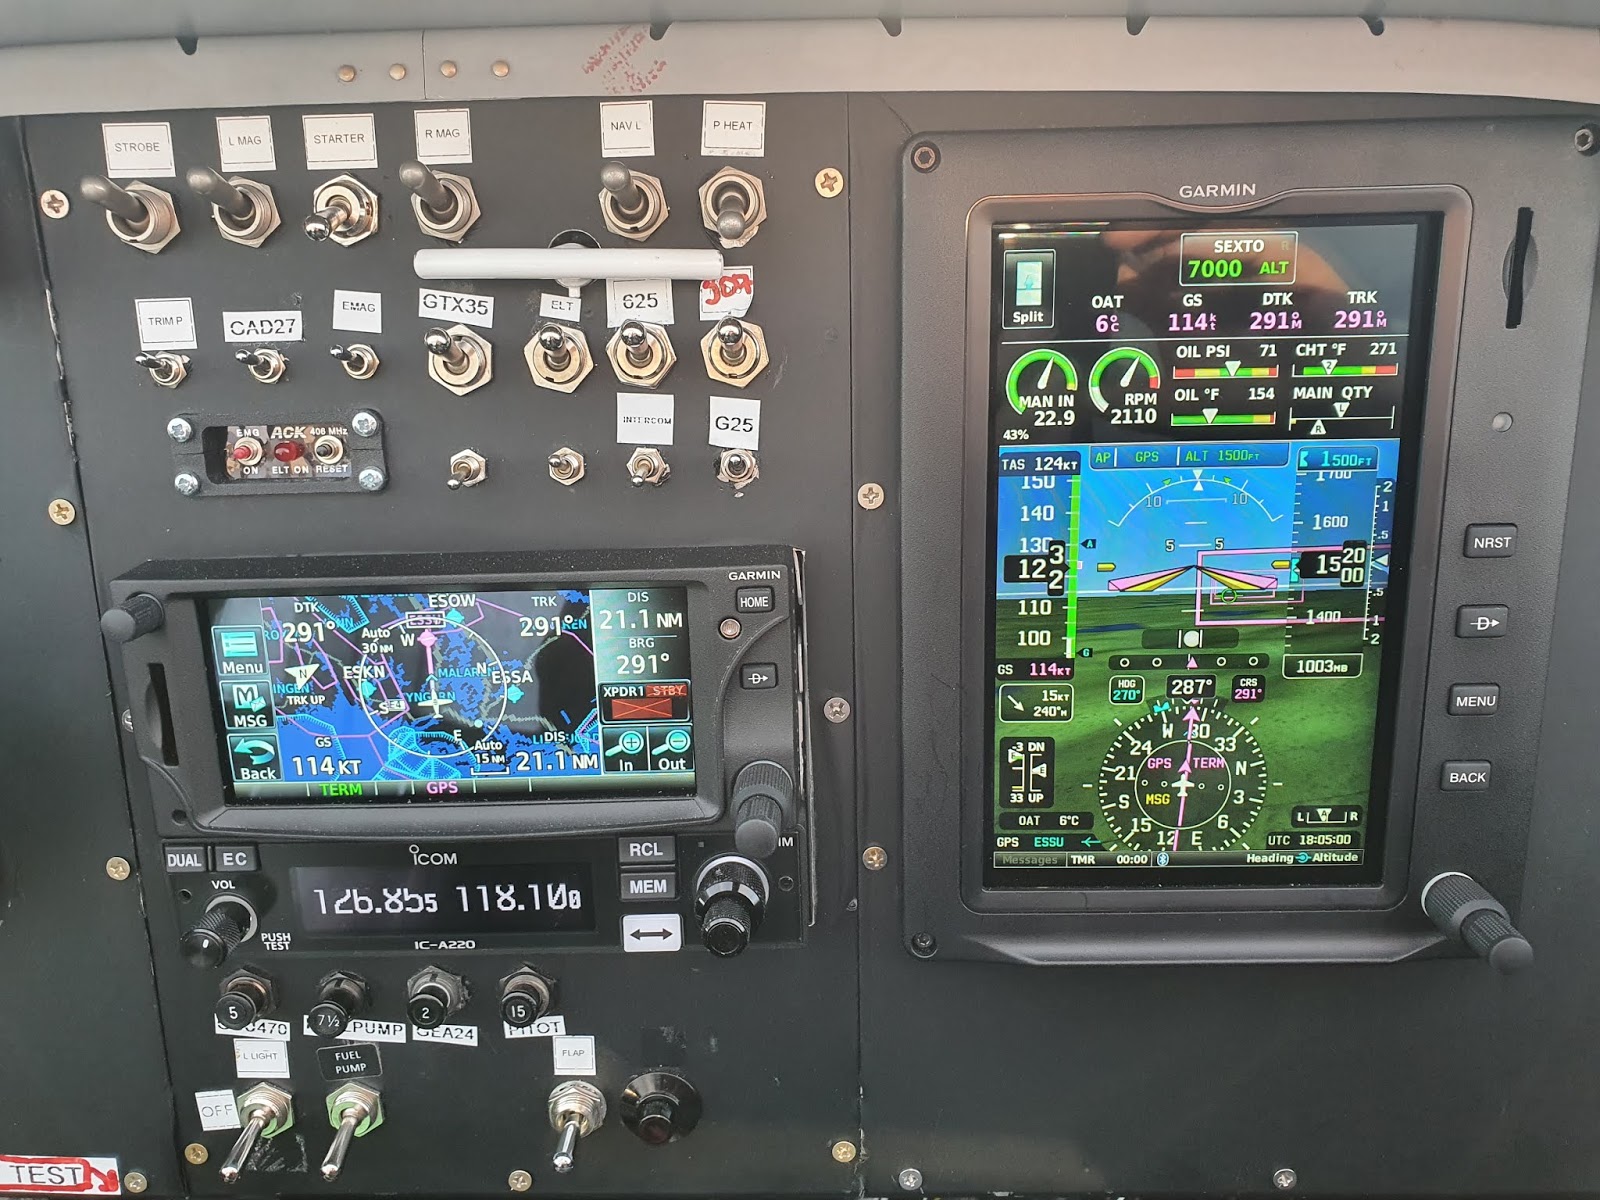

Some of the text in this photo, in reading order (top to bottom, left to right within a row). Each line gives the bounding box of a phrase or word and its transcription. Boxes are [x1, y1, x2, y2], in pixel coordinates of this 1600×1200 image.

[611, 120, 641, 131] NAV L
[713, 120, 753, 131] P HEAT
[313, 133, 365, 145] STARTER
[425, 127, 460, 139] R MAG
[228, 134, 262, 146] L MAG
[114, 141, 161, 153] STROBE
[1179, 183, 1257, 198] GARMIN
[1214, 240, 1265, 253] SEXTO
[1188, 259, 1290, 278] 7000 ALT
[622, 293, 658, 309] 625
[1091, 295, 1124, 309] OAT
[1182, 294, 1203, 307] GS
[1262, 292, 1294, 306] DTK
[1347, 290, 1378, 304] TRK
[342, 301, 376, 313] EMAG
[423, 293, 489, 316] GTX35
[551, 300, 574, 312] ELT
[148, 316, 183, 328] TRIM P
[1012, 311, 1044, 325] Split
[230, 318, 296, 336] CAD27
[1175, 344, 1278, 359] OIL PSI 71
[1295, 342, 1397, 357] CHT 271
[1174, 387, 1276, 401] OIL 154
[1293, 385, 1373, 399] MAIN QTY
[1019, 394, 1075, 408] MAN IN
[1124, 392, 1158, 406] RPM
[623, 416, 672, 425] INTERCOM
[1033, 410, 1076, 427] 22.9
[1110, 408, 1158, 425] 2110
[328, 427, 348, 435] MHz
[715, 416, 754, 433] G25
[236, 429, 260, 437] EMG
[270, 426, 307, 439] ACK
[1002, 429, 1030, 440] 43%
[1095, 450, 1208, 463] AP GPS ALT
[272, 465, 309, 474] ELT ON
[315, 464, 348, 473] RESET
[1001, 456, 1078, 471] TAS 124KT
[243, 466, 259, 475] ON
[1020, 505, 1055, 522] 140
[1312, 514, 1349, 530] 1600
[1474, 536, 1512, 549] NRST
[728, 570, 781, 581] GARMIN
[428, 593, 476, 608] ESOW
[531, 596, 557, 607] TRK
[627, 591, 649, 603] DIS
[740, 596, 769, 608] HOME
[294, 602, 320, 613] DTK
[1017, 600, 1052, 616] 110
[599, 608, 649, 630] 21.1
[657, 613, 683, 628] NM
[1305, 609, 1341, 625] 1400
[282, 620, 336, 643] 291°
[519, 614, 574, 637] 291°
[361, 627, 391, 639] Auto
[1017, 630, 1051, 647] 100
[362, 643, 378, 654] 30
[629, 637, 655, 648] BRG
[222, 661, 264, 674] Menu
[616, 652, 670, 675] 291°
[997, 662, 1072, 676] GS 114KT
[343, 666, 386, 679] ESKN
[491, 669, 533, 684] ESSA
[1118, 679, 1136, 688] HDG
[1171, 679, 1213, 695] 287°
[1239, 678, 1258, 687] CRS
[603, 685, 683, 697] XPDR1 STBY
[1113, 689, 1141, 701] 270°
[1234, 688, 1263, 700] 291°
[286, 695, 326, 705] TRK UP
[1455, 696, 1497, 707] MENU
[233, 715, 268, 728] MSG
[315, 737, 331, 748] GS
[544, 731, 566, 742] DIS
[474, 740, 503, 751] Auto
[1027, 741, 1045, 752] DN
[1130, 740, 1152, 756] 24
[1214, 737, 1237, 752] 33
[476, 753, 489, 764] 15
[516, 750, 598, 771] 21.1 NM
[619, 758, 686, 772] In Out
[1147, 757, 1225, 769] GPS TERM
[292, 756, 361, 776] 114 KT
[241, 767, 277, 780] Back
[1114, 766, 1136, 781] 21
[1449, 772, 1487, 783] BACK
[319, 782, 458, 795] TERM GPS
[1010, 793, 1044, 803] 33 UP
[1146, 794, 1171, 805] MSG
[1018, 815, 1080, 826] OAT 6°C
[1131, 817, 1152, 833] 15
[996, 836, 1064, 848] GPS ESSU
[1267, 834, 1352, 846] UTC 18:05:00
[629, 842, 663, 857] RCL
[167, 853, 201, 867] DUAL
[223, 852, 247, 866] EC
[1002, 855, 1058, 866] Messages
[1070, 854, 1148, 865] TMR 00:00
[1246, 852, 1359, 864] Heading Altitude
[211, 880, 235, 889] VOL
[629, 880, 668, 894] MEM
[313, 888, 438, 915] 126.855
[455, 883, 581, 912] 118.100
[261, 933, 291, 942] PUSH
[263, 941, 290, 950] TEST
[415, 940, 476, 950] IC-A220
[229, 1007, 238, 1019] 5
[422, 1007, 430, 1019] 2
[511, 1005, 526, 1018] 15
[251, 1052, 278, 1060] LIGHT
[335, 1051, 362, 1061] FUEL
[562, 1049, 585, 1057] FLAP
[335, 1063, 367, 1074] PUMP
[202, 1104, 233, 1118] OFF
[9, 1165, 82, 1185] TEST
